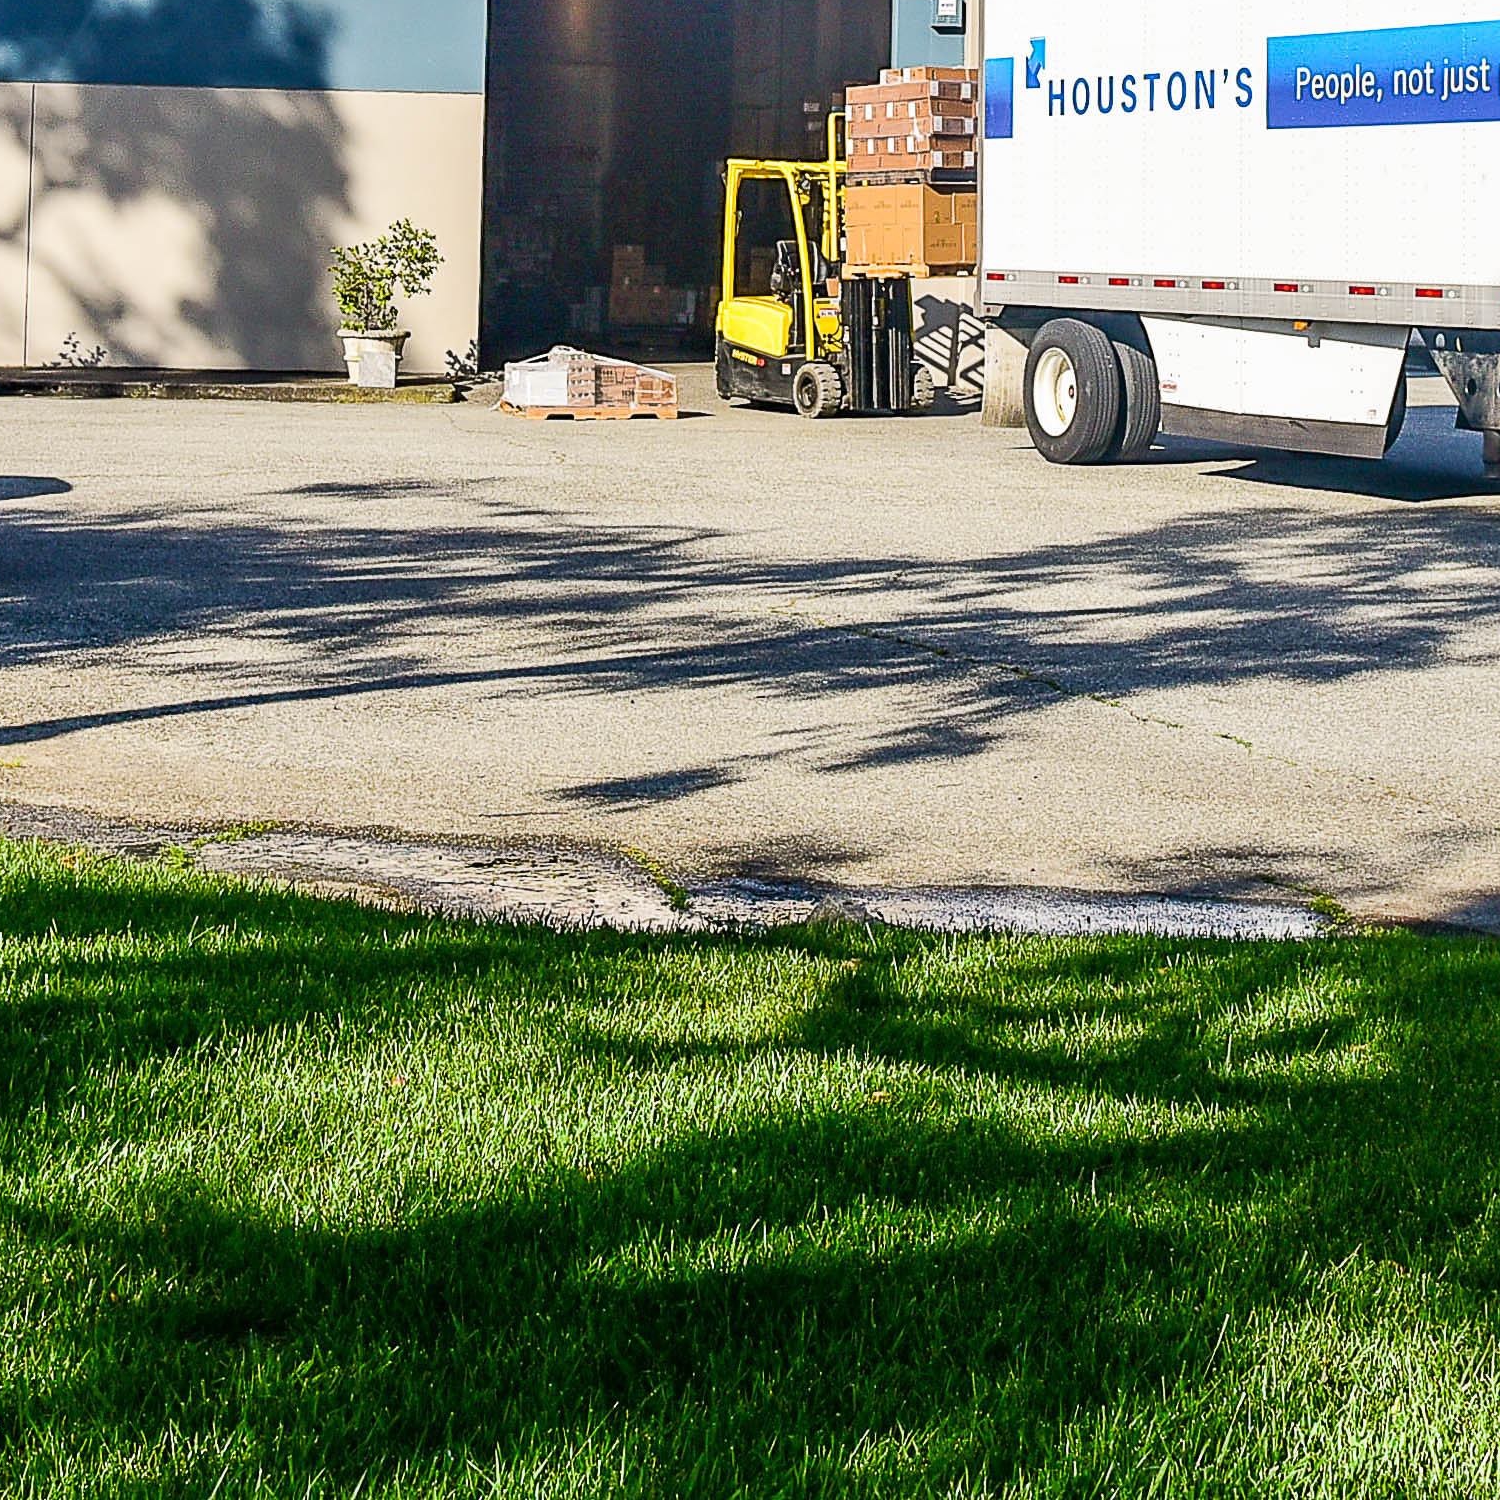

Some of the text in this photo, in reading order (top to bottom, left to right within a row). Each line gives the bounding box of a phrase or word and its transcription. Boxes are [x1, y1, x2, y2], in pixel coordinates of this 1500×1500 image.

[1047, 66, 1253, 116] HOUSTON'S
[1296, 64, 1384, 103] People,
[1394, 62, 1434, 95] not
[1442, 58, 1491, 101] just
